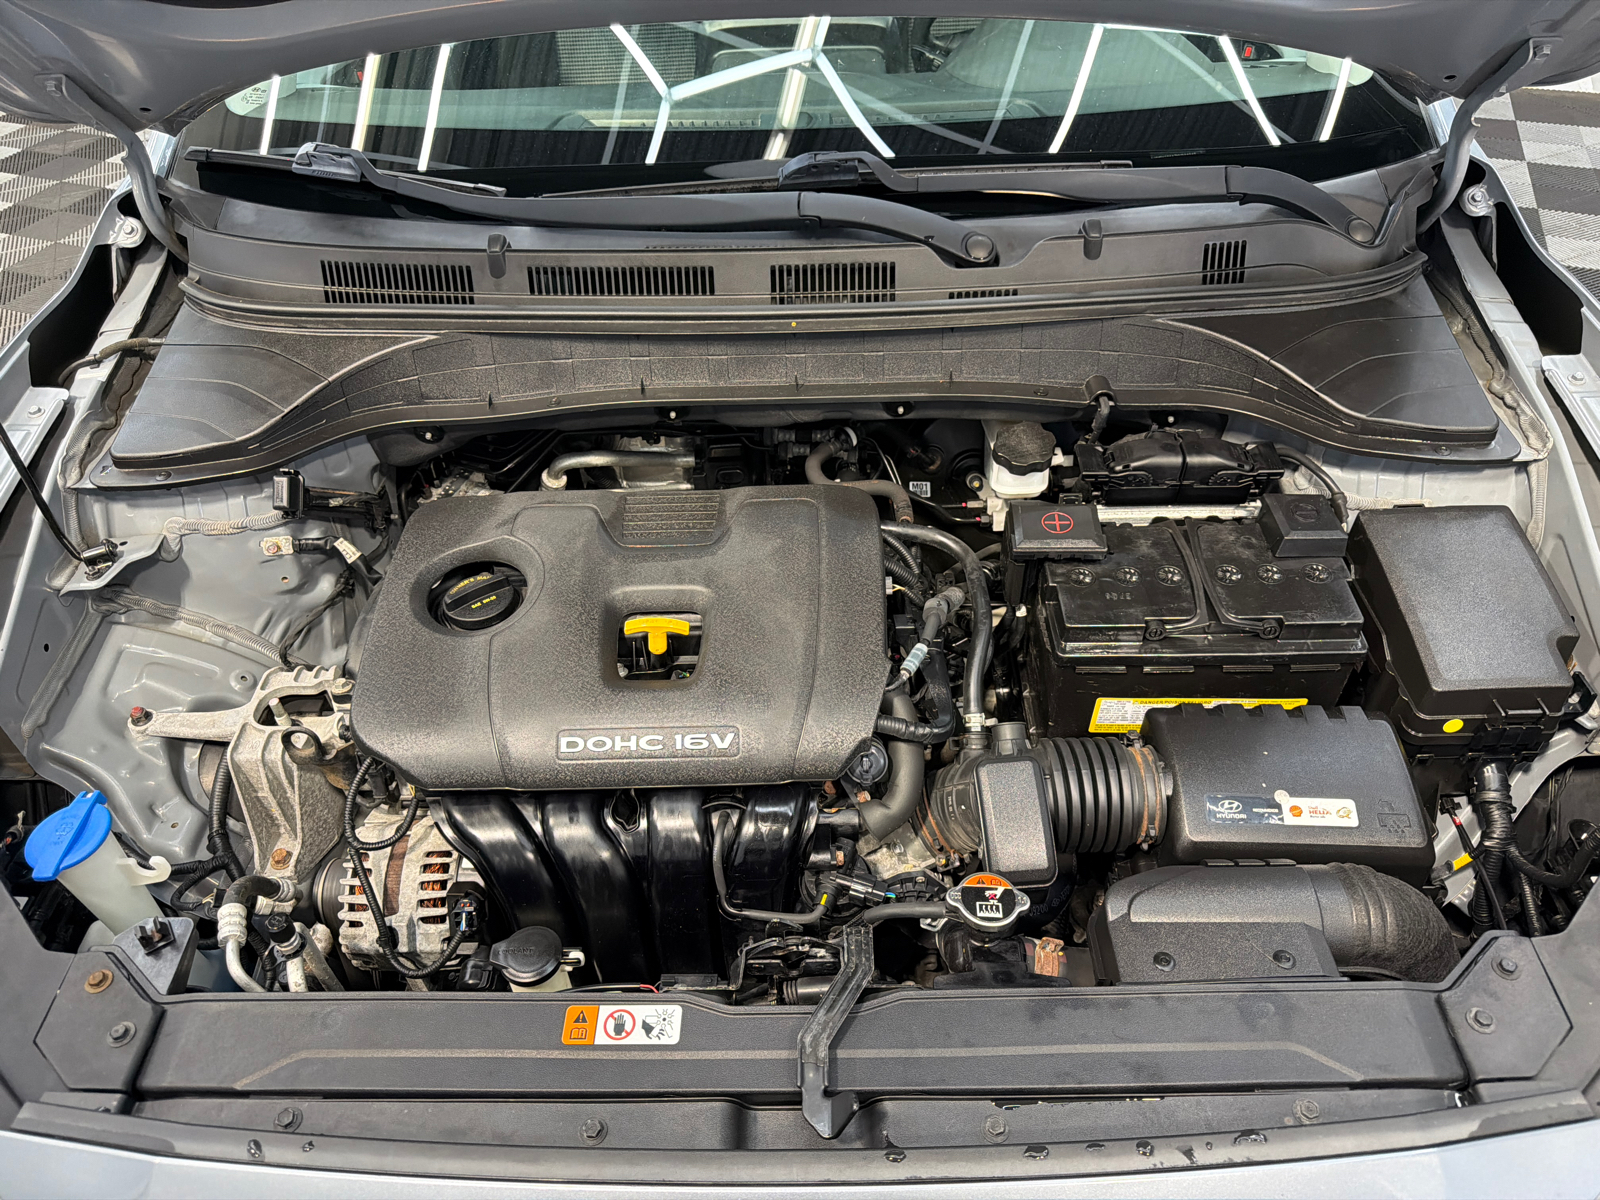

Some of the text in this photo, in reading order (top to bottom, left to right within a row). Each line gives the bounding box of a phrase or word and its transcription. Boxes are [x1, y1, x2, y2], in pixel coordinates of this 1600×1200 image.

[560, 732, 736, 753] DOHC 16V
[497, 947, 535, 956] COOLANT
